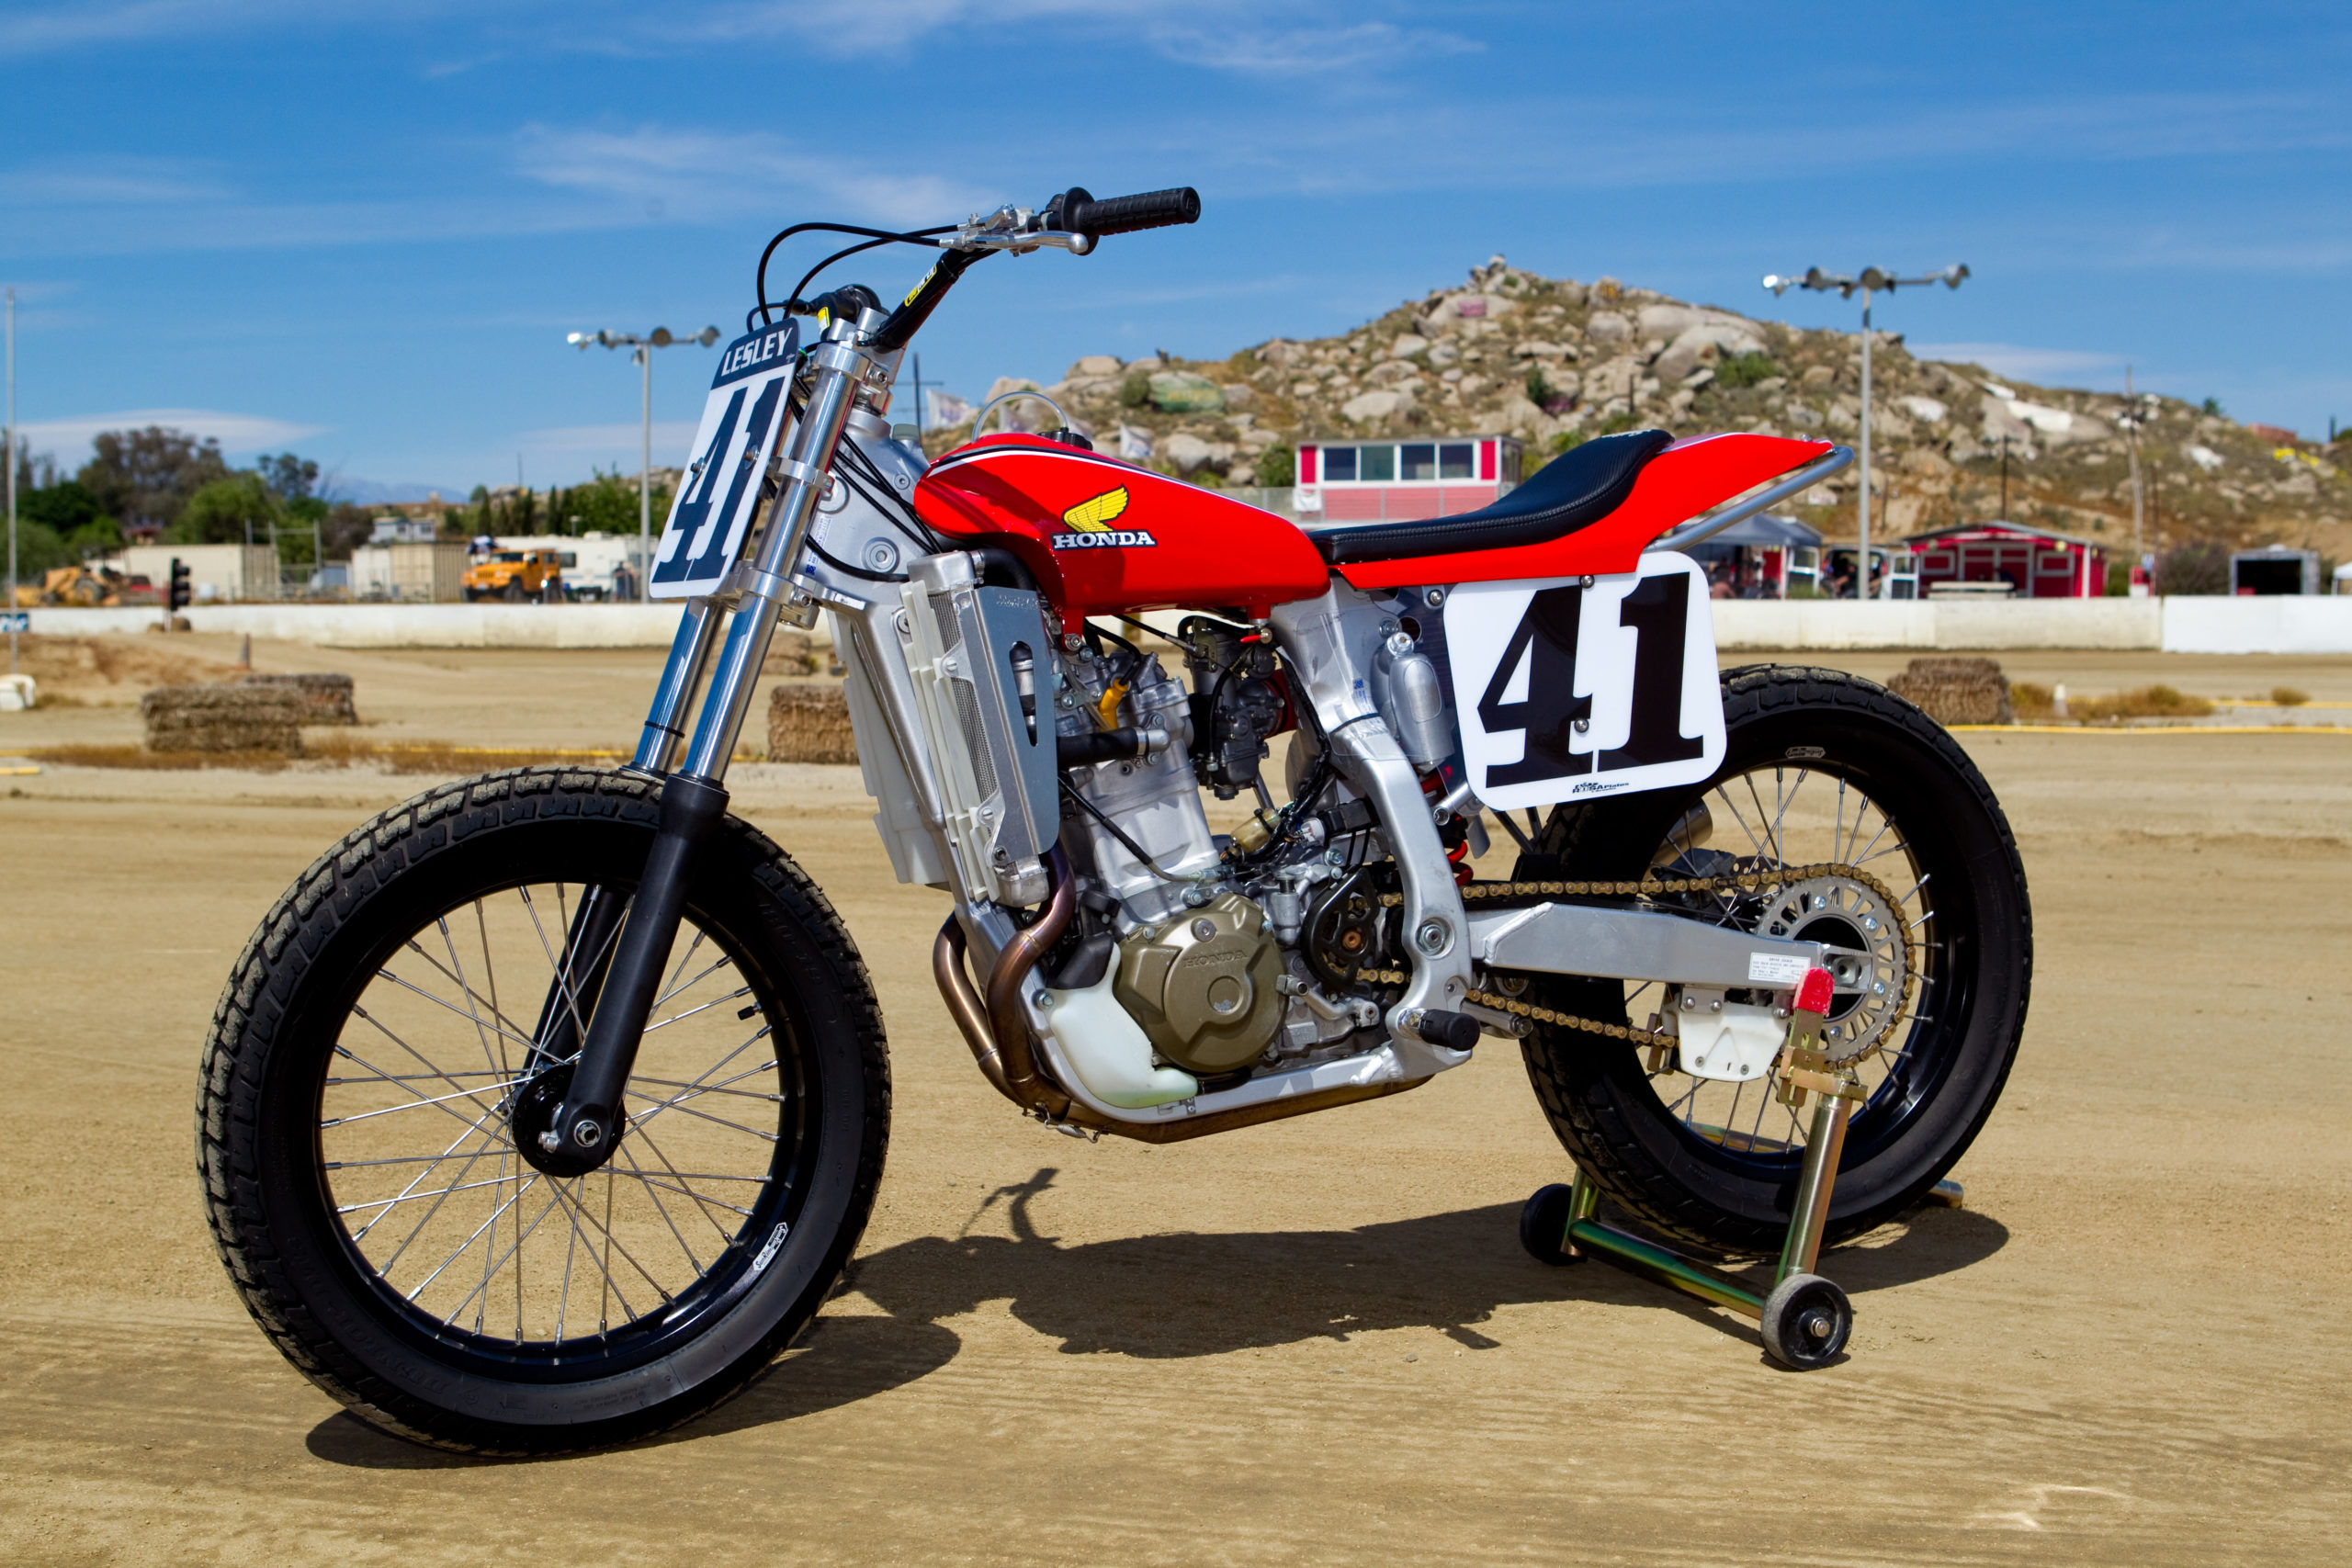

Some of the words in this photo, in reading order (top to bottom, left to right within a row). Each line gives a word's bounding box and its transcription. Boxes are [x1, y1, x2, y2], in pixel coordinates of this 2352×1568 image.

[721, 327, 793, 377] LESLEY
[651, 376, 786, 583] 41
[1053, 532, 1156, 549] HONDA
[1477, 571, 1704, 788] 41
